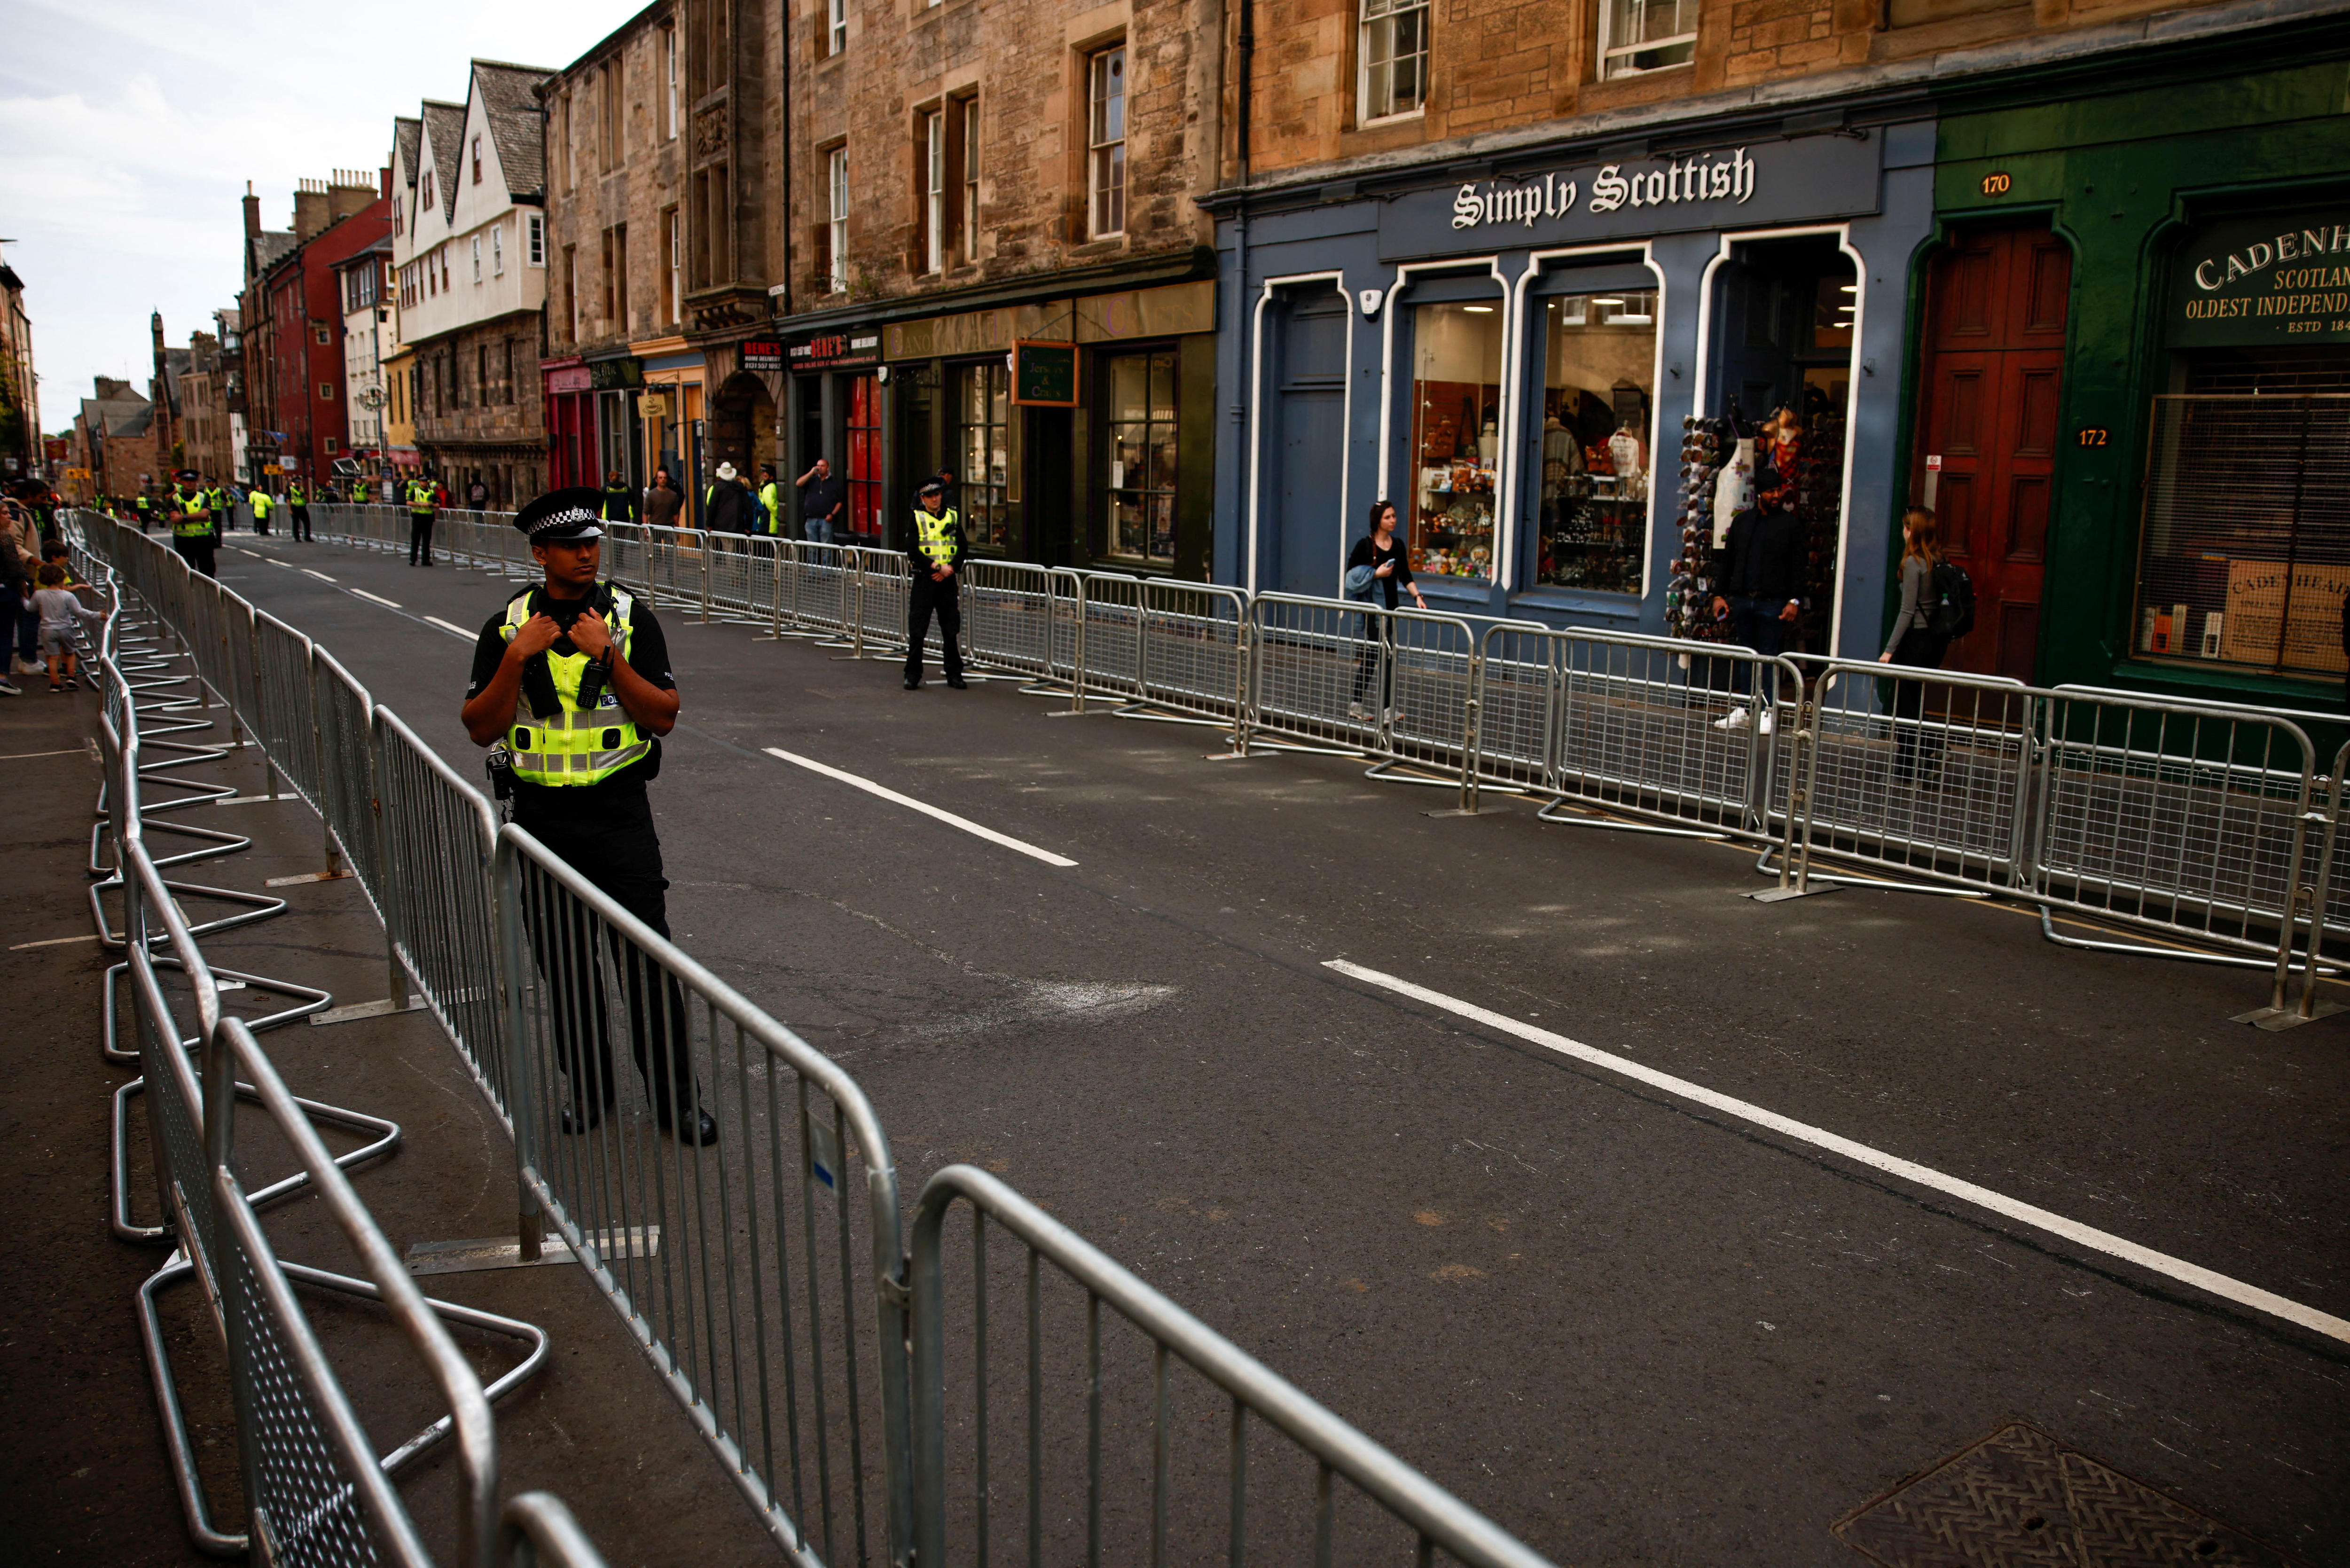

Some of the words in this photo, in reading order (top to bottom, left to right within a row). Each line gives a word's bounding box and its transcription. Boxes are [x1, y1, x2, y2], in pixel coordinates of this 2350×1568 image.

[1452, 173, 1576, 229] Simply
[1590, 147, 1755, 214] Scottish
[1982, 174, 2010, 194] 170
[2186, 297, 2252, 319] OLDEST
[2256, 292, 2350, 316] INDEPEND
[2288, 321, 2321, 333] ESTD
[744, 342, 781, 355] BENE'S
[810, 335, 842, 358] BENE'S
[2079, 429, 2107, 446] 172
[602, 695, 619, 705] POL
